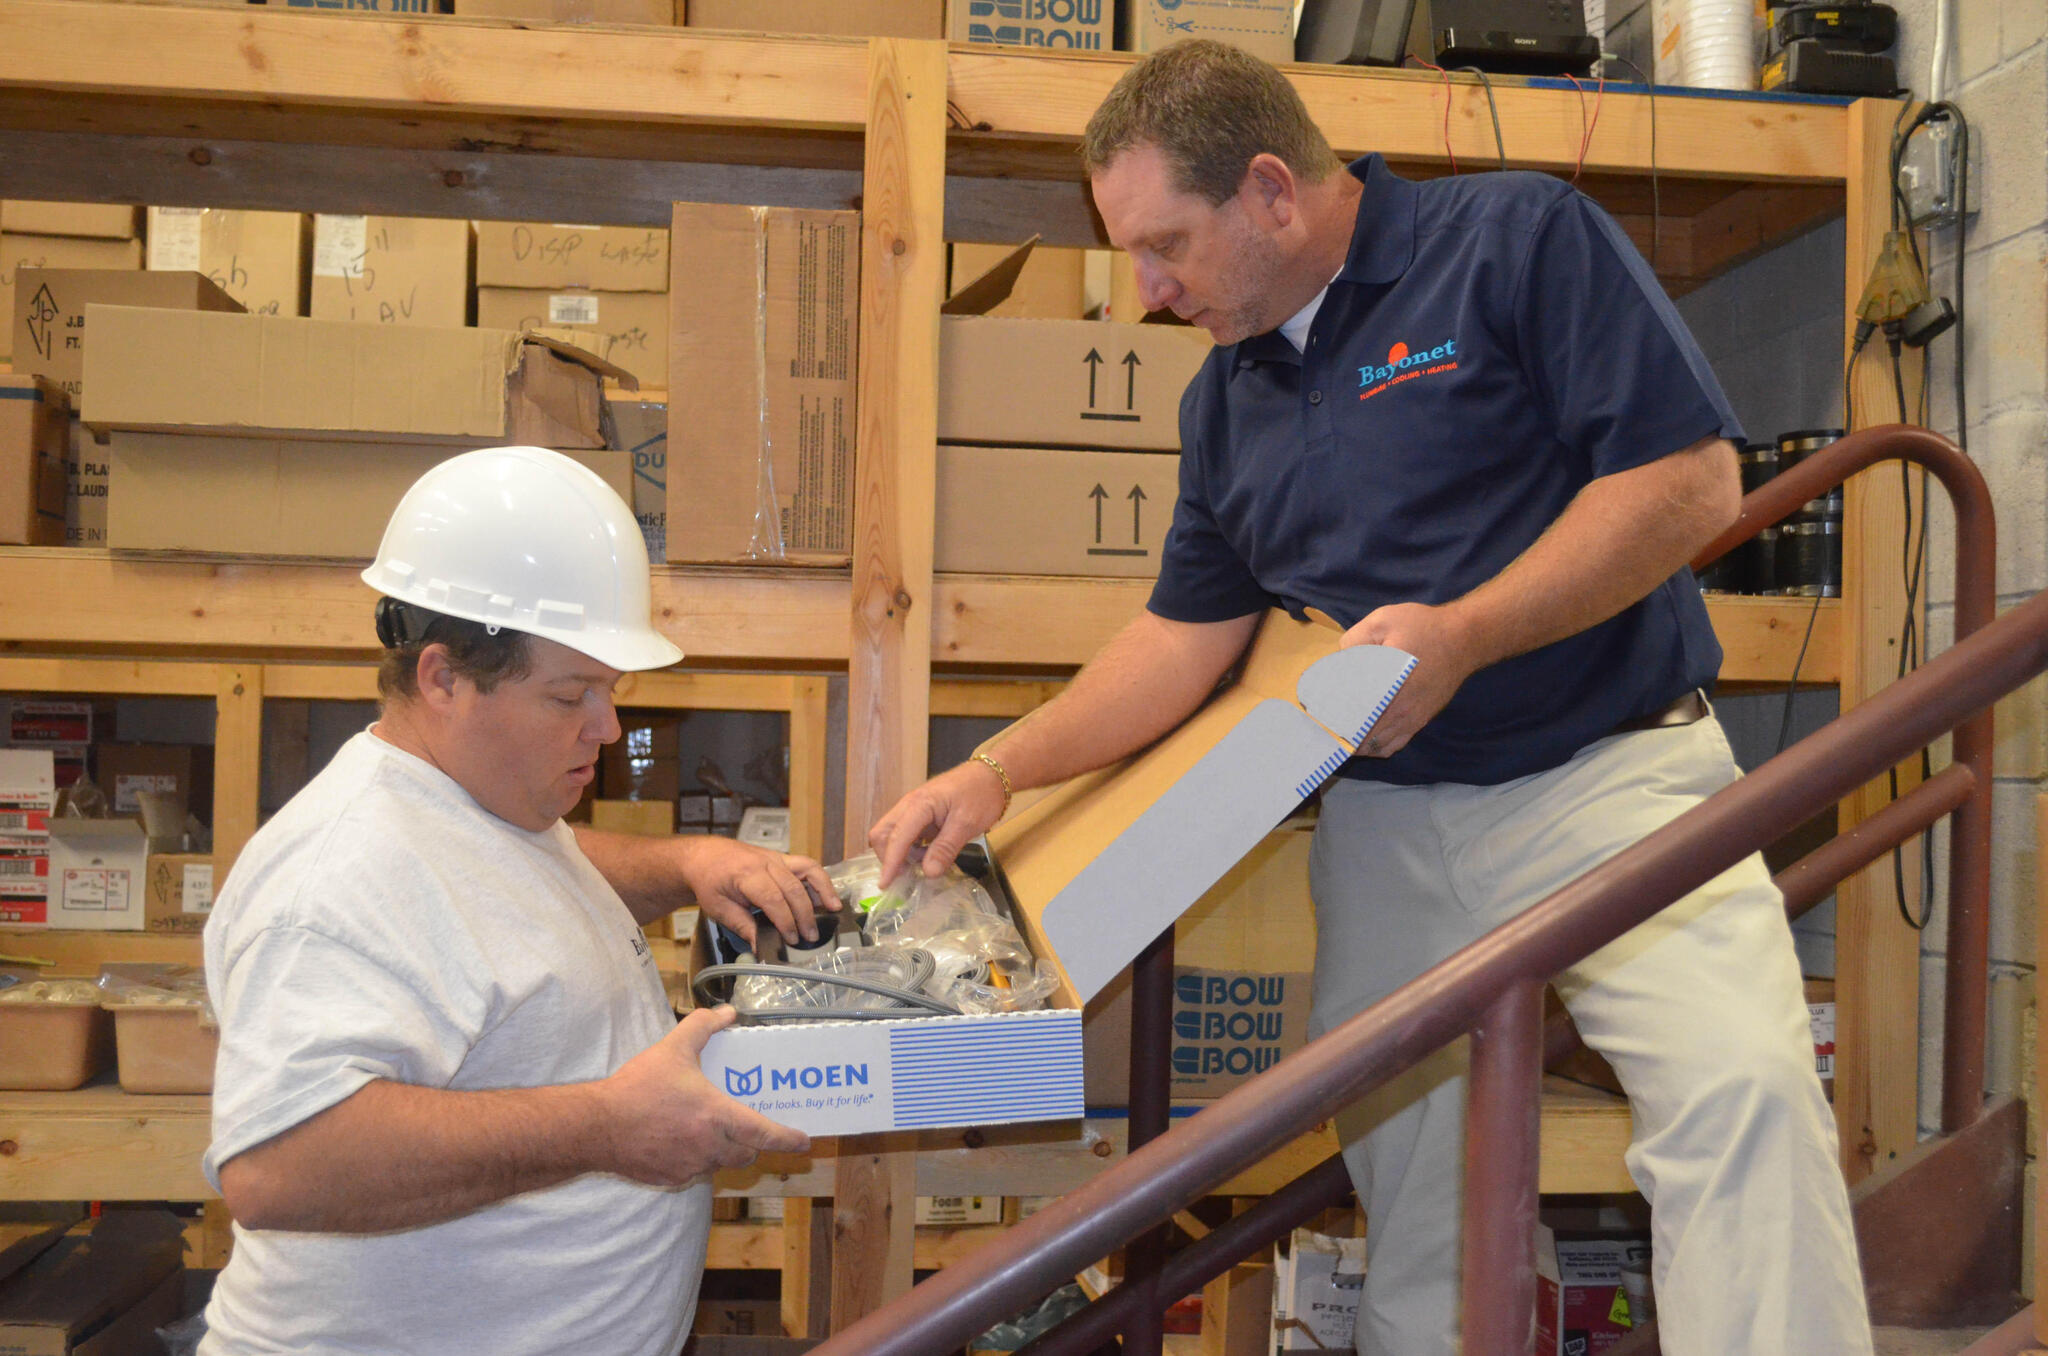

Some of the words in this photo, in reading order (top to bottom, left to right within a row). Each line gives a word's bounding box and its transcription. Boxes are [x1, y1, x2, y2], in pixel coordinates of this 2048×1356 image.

[1357, 338, 1456, 388] Bayonet
[1391, 370, 1420, 385] COOLING
[1427, 361, 1458, 376] HEATING
[84, 463, 109, 476] PLA
[634, 452, 665, 468] DU
[1206, 977, 1285, 1005] BOW
[1204, 1012, 1282, 1040] BOW
[1201, 1046, 1281, 1076] BOW
[771, 1063, 869, 1091] MOEN
[758, 1100, 773, 1113] for
[775, 1099, 802, 1111] looks.
[805, 1098, 825, 1110] Buy
[826, 1096, 835, 1106] it
[835, 1095, 851, 1108] for
